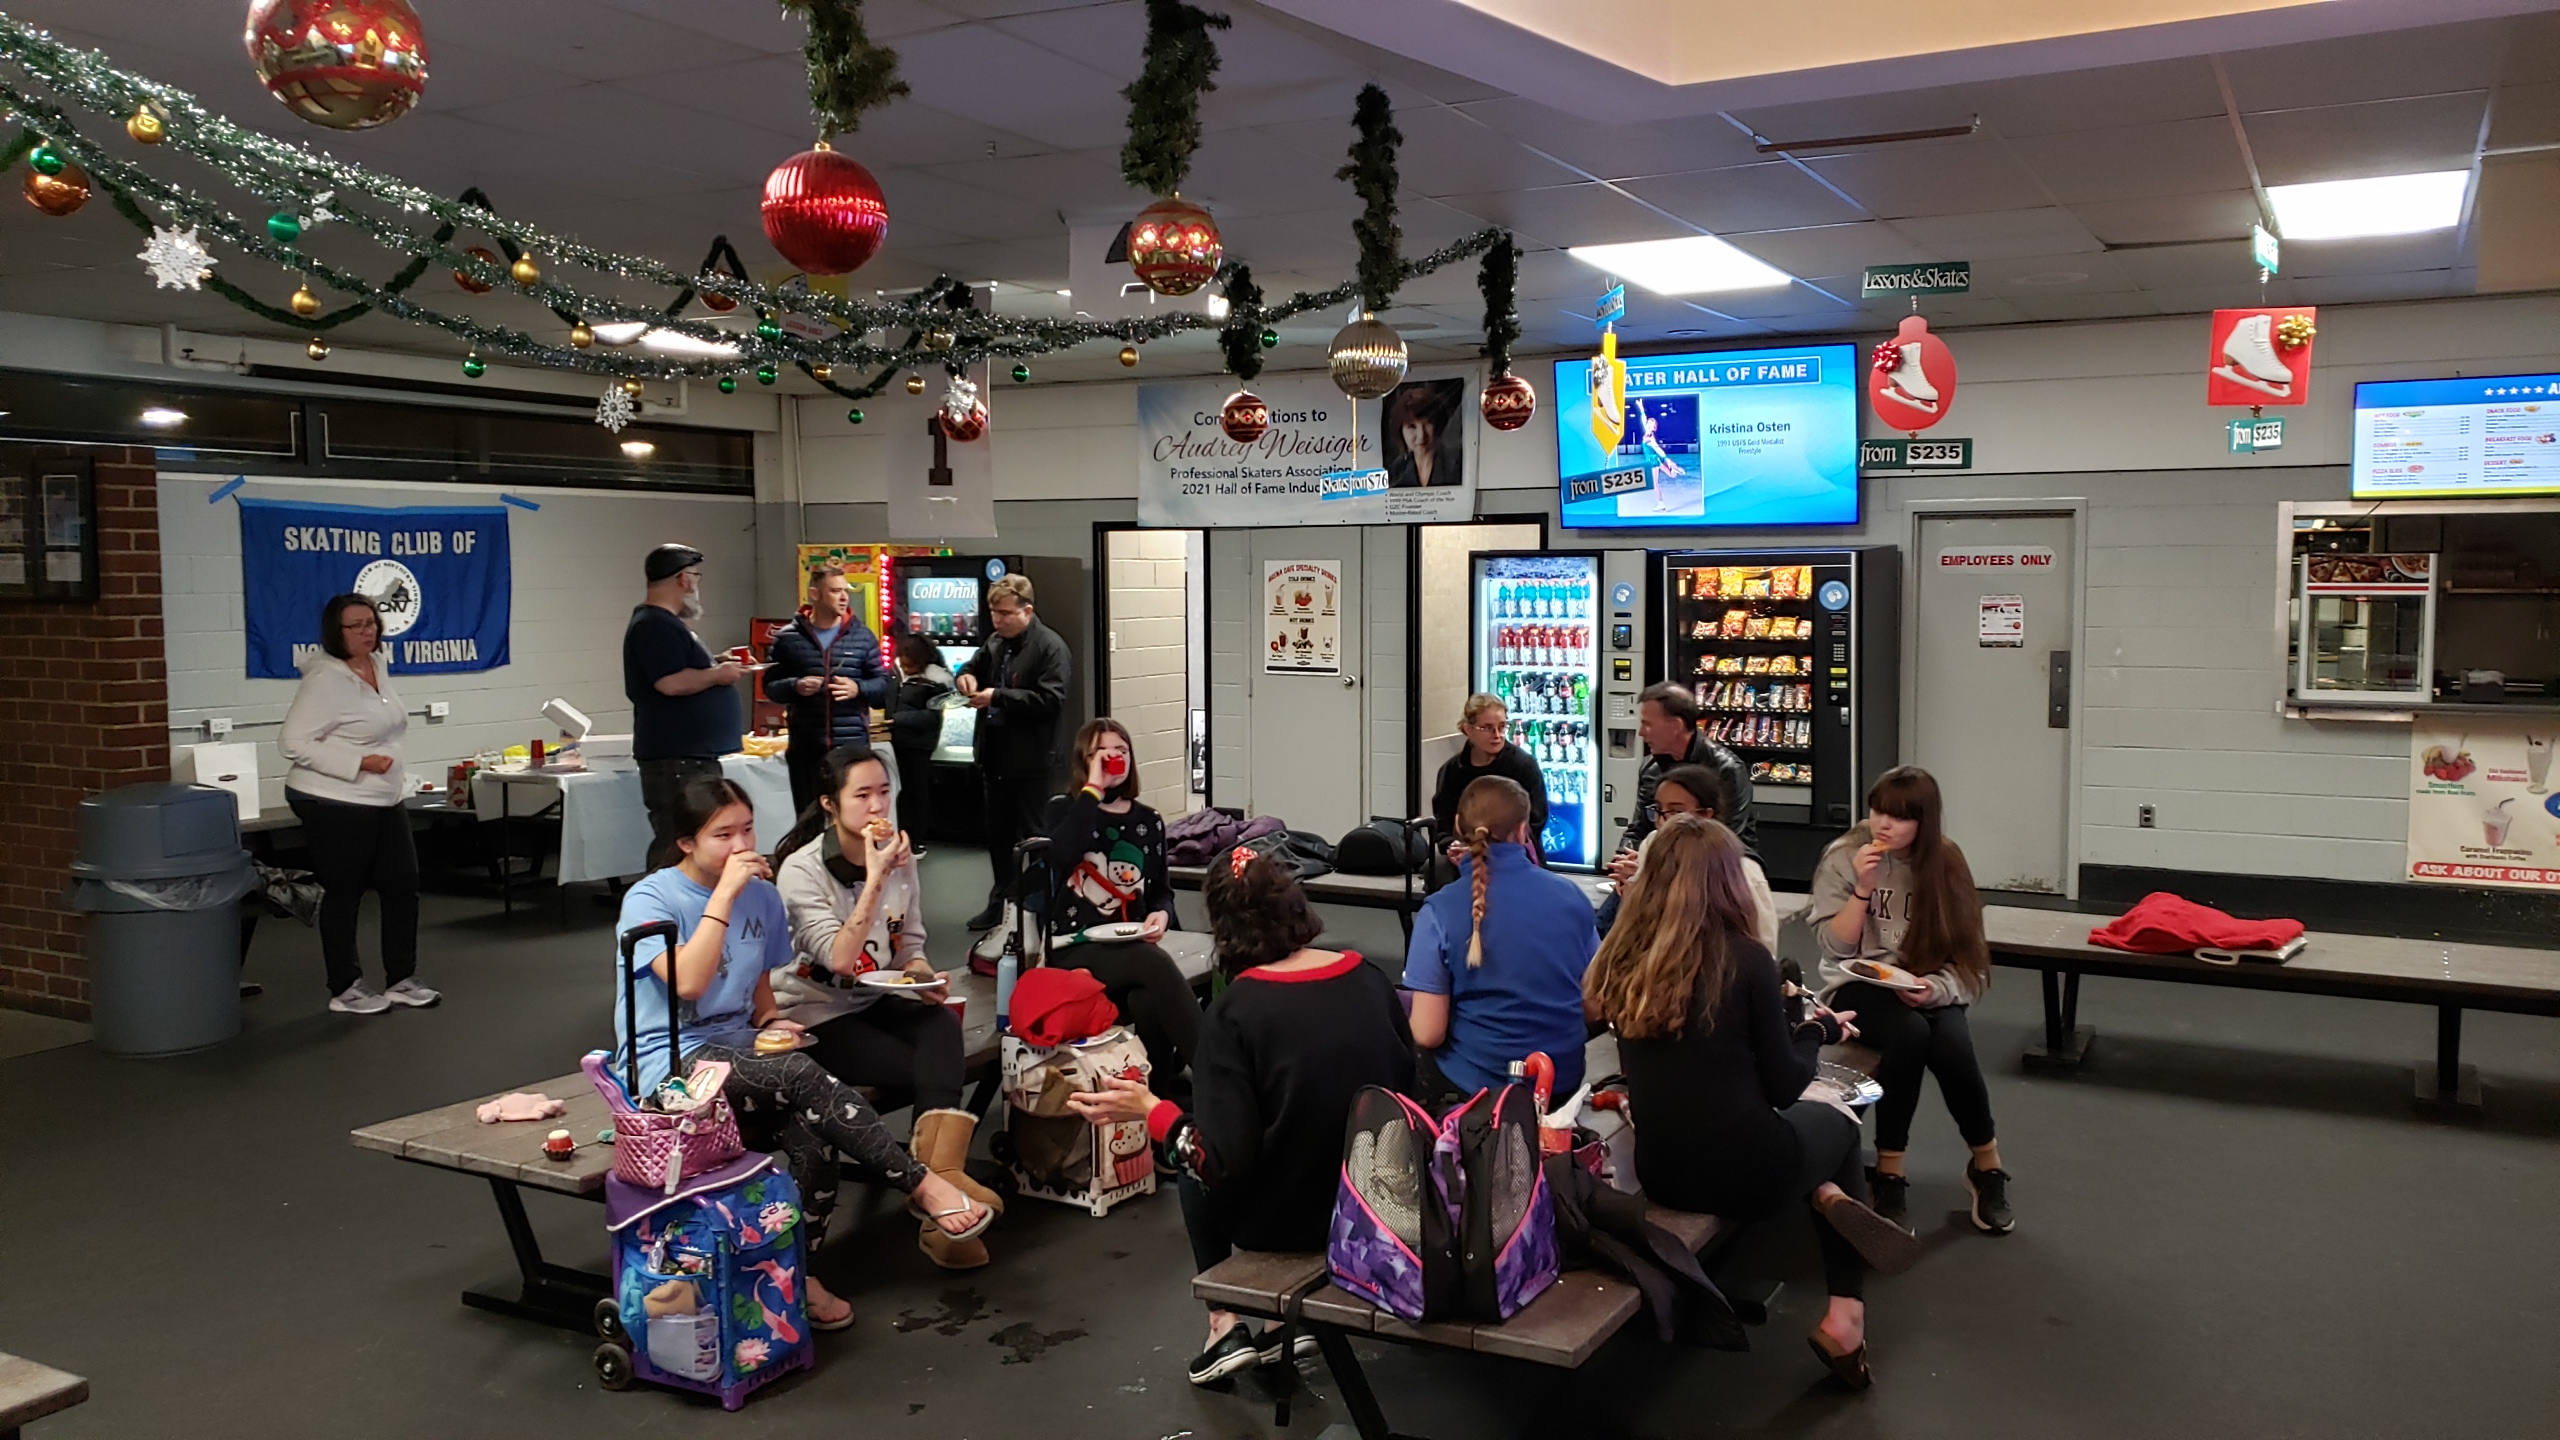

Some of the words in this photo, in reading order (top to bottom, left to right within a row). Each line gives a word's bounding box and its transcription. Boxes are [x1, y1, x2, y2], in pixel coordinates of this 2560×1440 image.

[1626, 371, 1667, 387] ATER
[1673, 368, 1720, 385] HALL
[1727, 366, 1751, 381] OF
[1758, 363, 1808, 380] FAME
[1194, 409, 1307, 426] Contions
[1312, 409, 1327, 422] to
[1709, 423, 1753, 434] Kristina
[1757, 422, 1791, 432] Osten
[2254, 424, 2279, 441] $235
[1153, 430, 1252, 464] Audrey
[1259, 428, 1373, 461] Weisiger
[1860, 442, 1896, 467] from
[1909, 445, 1960, 460] $235
[1171, 468, 1238, 479] Professional
[1241, 467, 1282, 479] Skaters
[1182, 484, 1210, 495] 2021
[1215, 484, 1238, 494] Hall
[1240, 483, 1253, 494] of
[1255, 483, 1285, 494] Fame
[1289, 482, 1320, 494] Induc
[1570, 478, 1598, 501] from
[1604, 470, 1644, 490] $235
[284, 526, 381, 555] SKATING
[391, 531, 442, 555] CLUB
[452, 530, 476, 553] OF
[1941, 555, 2014, 566] EMPLOYEES
[2021, 554, 2052, 566] ONLY
[912, 581, 942, 599] Cold
[944, 581, 979, 599] Drink
[404, 638, 478, 664] VIRGINIA
[2419, 863, 2448, 876] ASK
[2452, 866, 2505, 879] ABOUT
[2508, 871, 2541, 881] OUR
